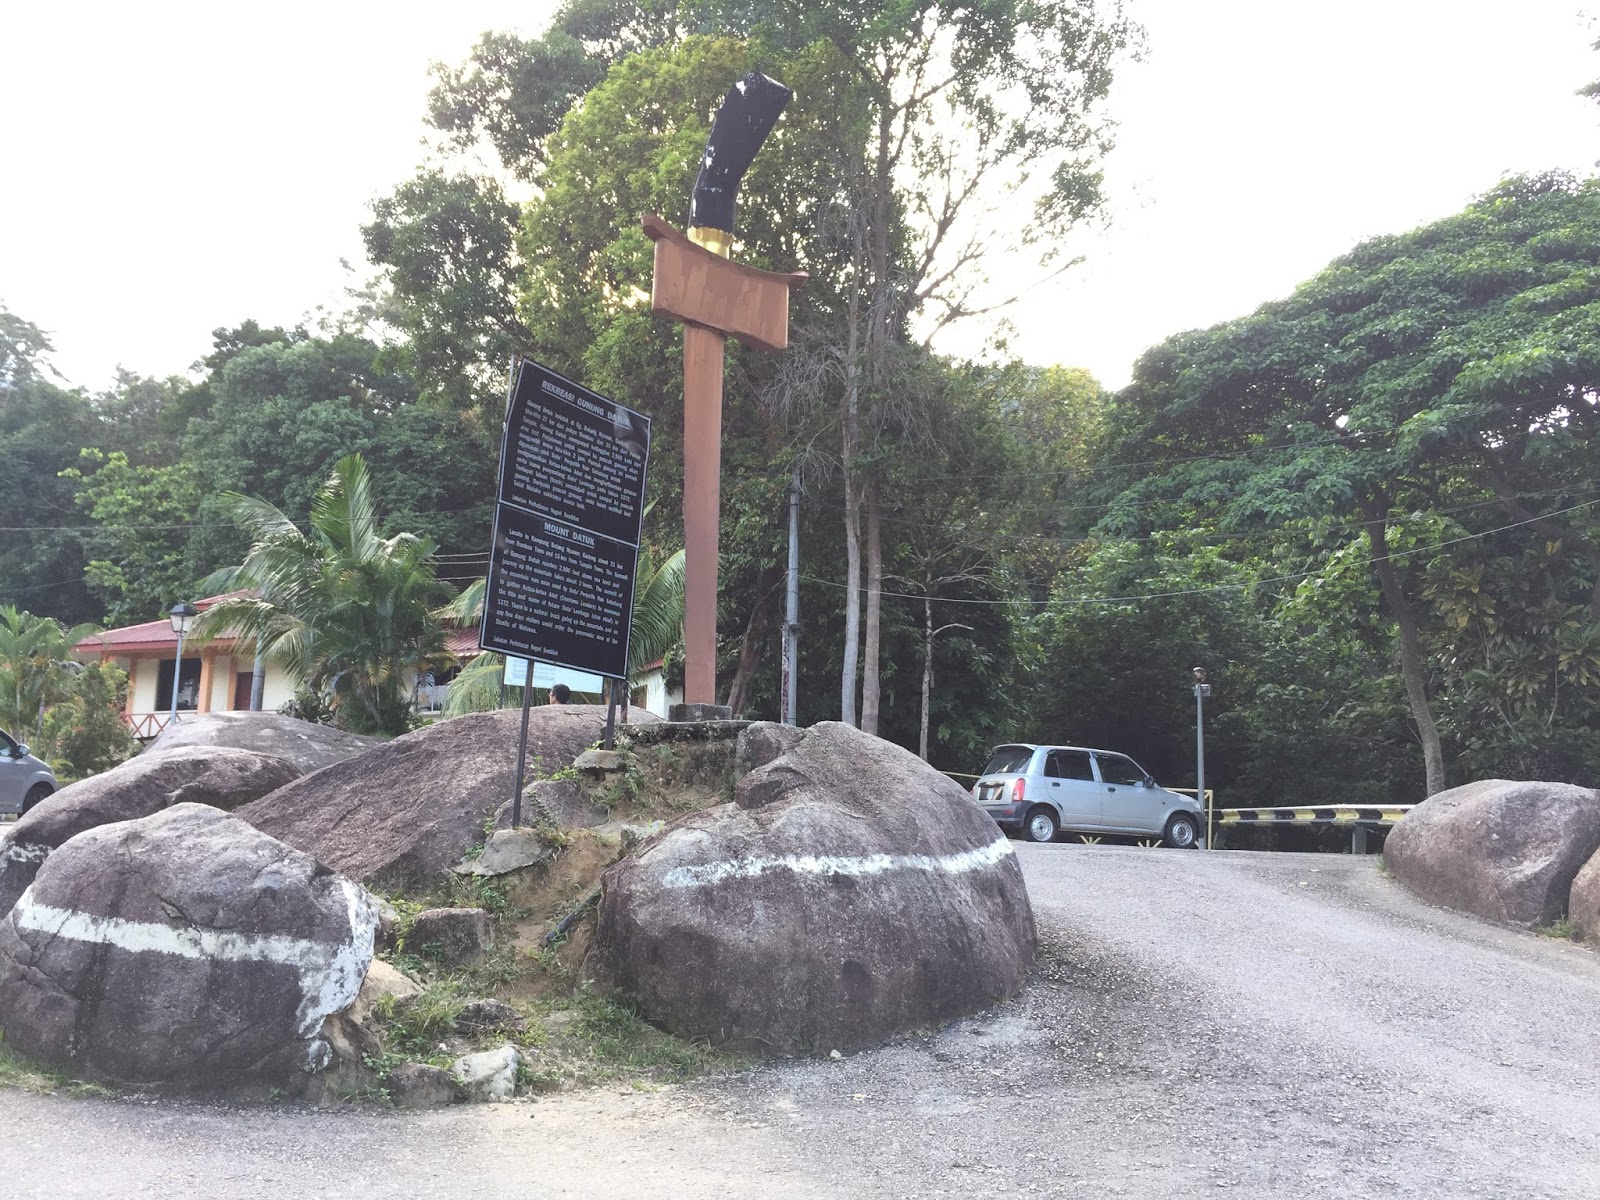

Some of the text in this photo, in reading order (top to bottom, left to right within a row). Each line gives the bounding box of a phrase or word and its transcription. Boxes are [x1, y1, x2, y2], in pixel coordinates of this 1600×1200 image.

[541, 380, 574, 402] REKREASI
[576, 396, 604, 415] GUNUNG
[544, 522, 595, 545] MOUNT DATUK
